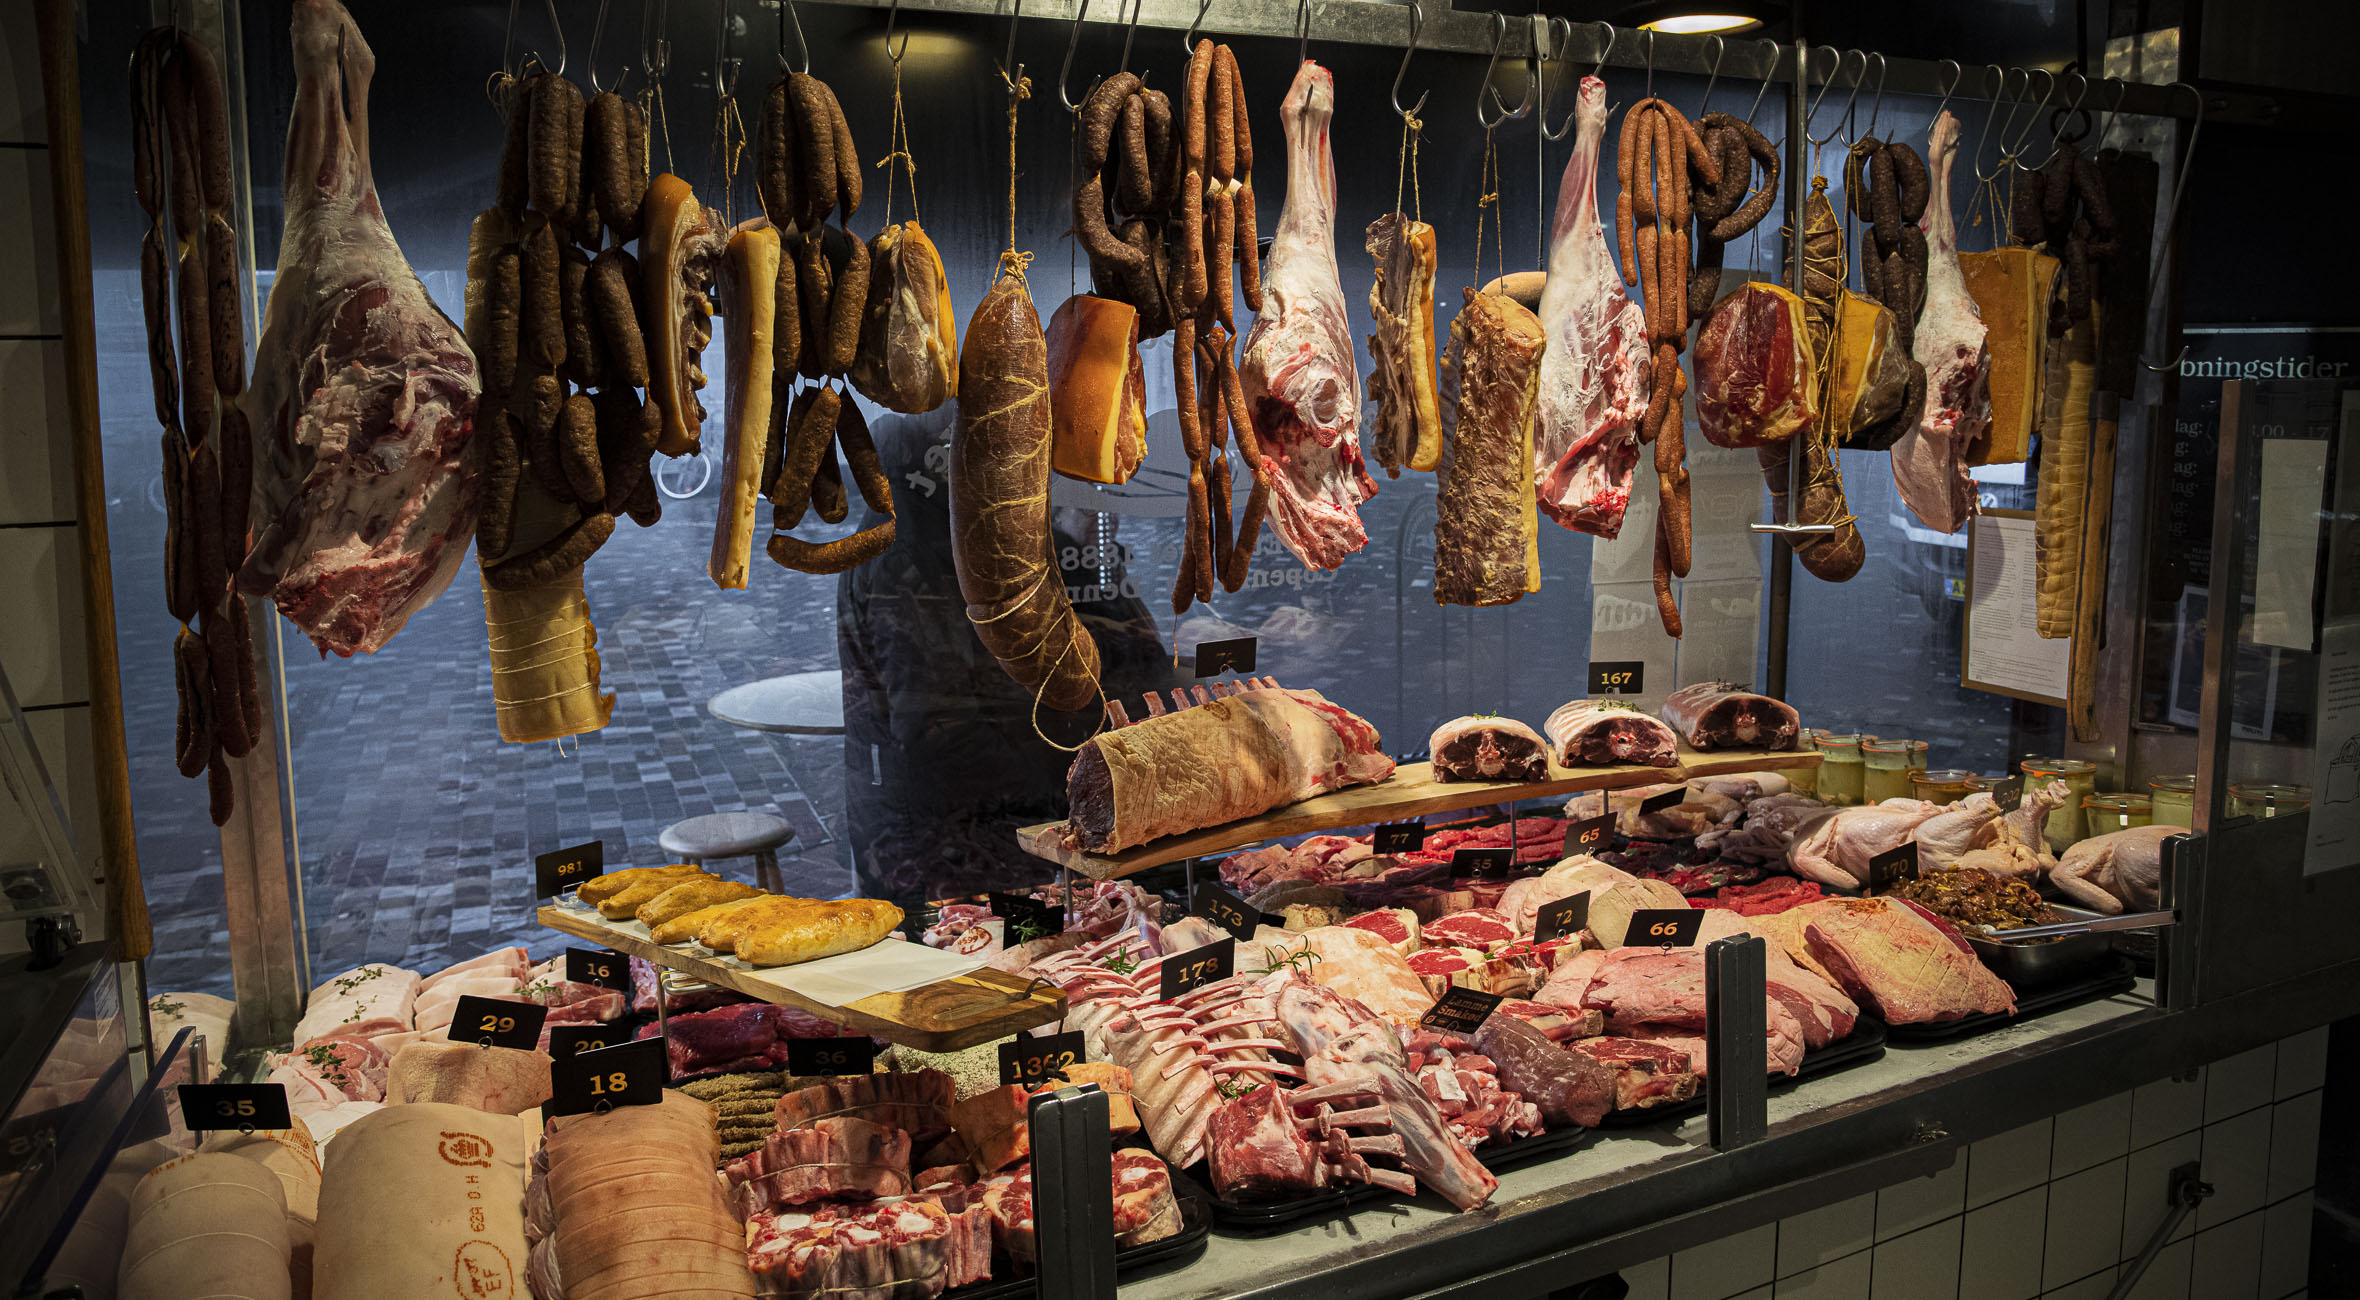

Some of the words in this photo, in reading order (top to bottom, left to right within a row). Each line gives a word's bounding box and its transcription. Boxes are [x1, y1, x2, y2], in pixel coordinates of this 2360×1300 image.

[2180, 355, 2350, 380] bningstider
[1601, 672, 1632, 685] 167
[1390, 833, 1411, 845] 77
[1579, 827, 1600, 845] 65
[557, 860, 583, 877] 981
[1207, 898, 1244, 927] 173
[1649, 922, 1679, 937] 66
[586, 963, 611, 979] 16
[1178, 957, 1220, 984] 178
[480, 1015, 516, 1033] 29
[815, 1050, 847, 1065] 36
[590, 1071, 628, 1096] 18
[216, 1099, 256, 1117] 35
